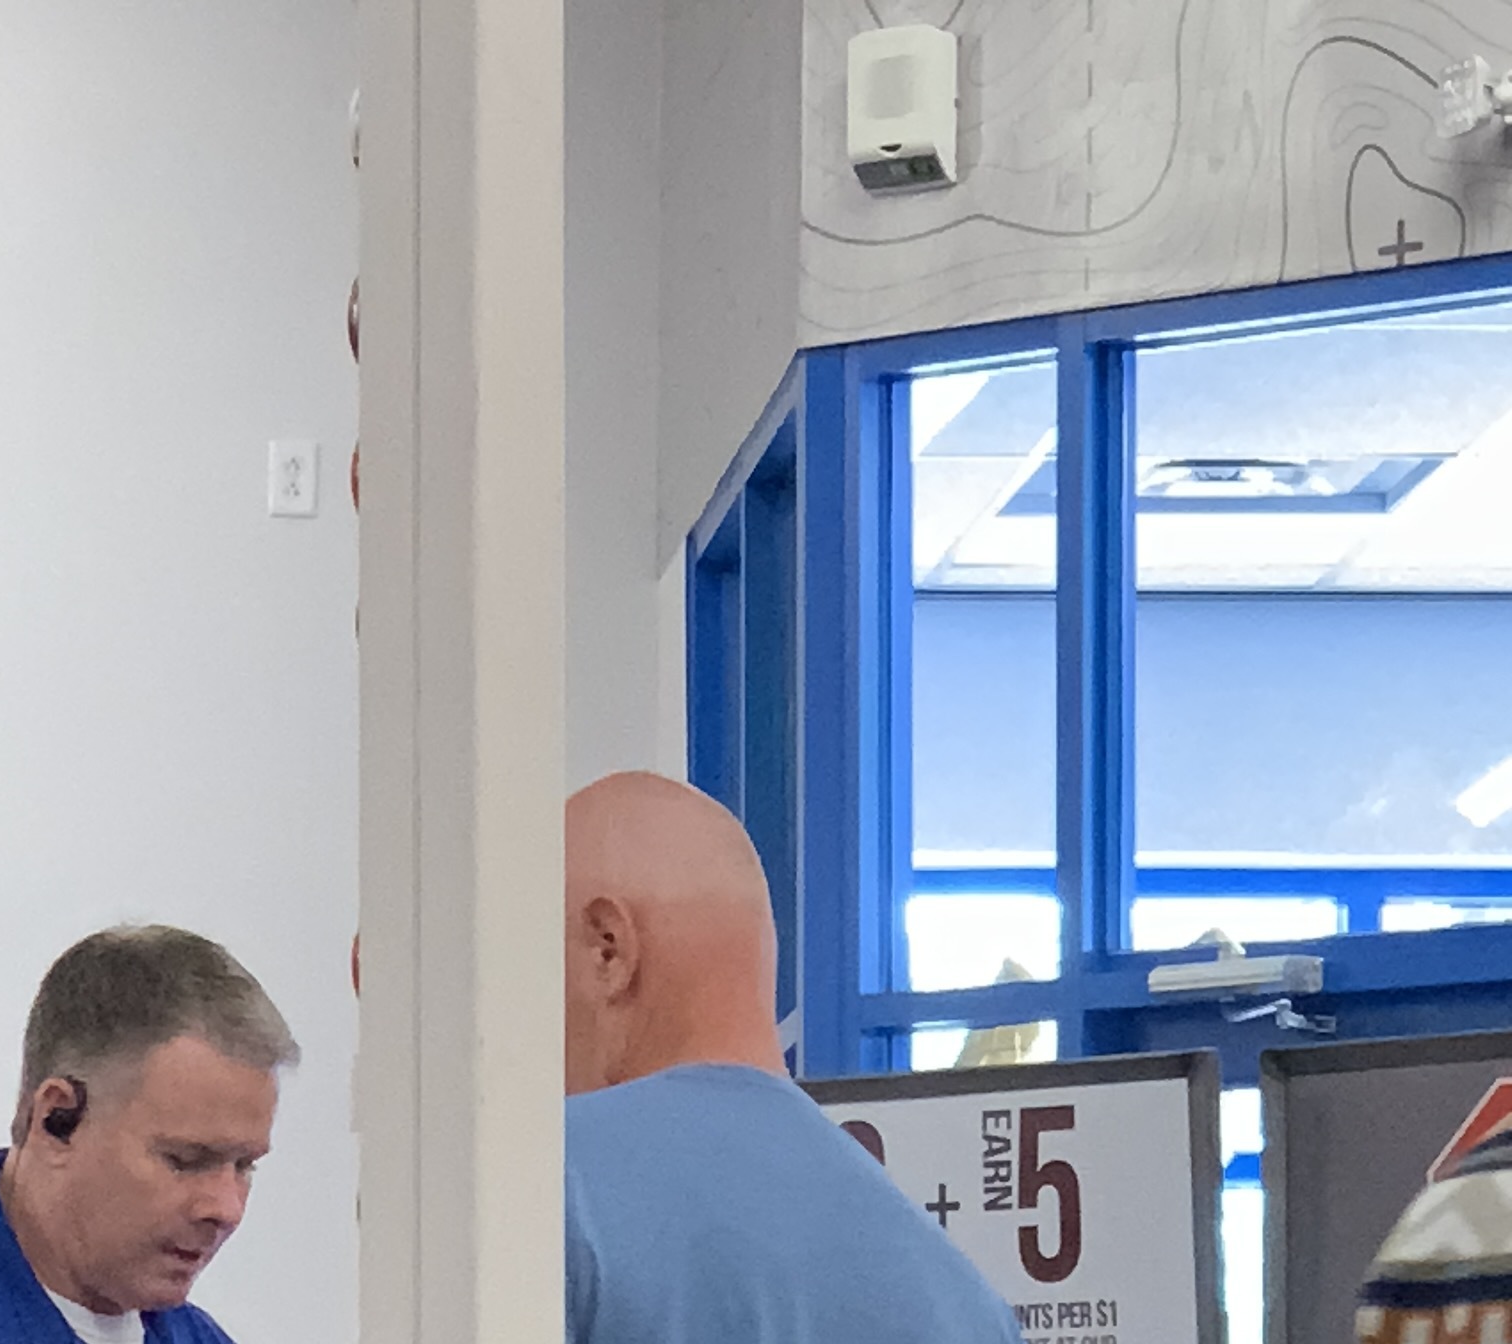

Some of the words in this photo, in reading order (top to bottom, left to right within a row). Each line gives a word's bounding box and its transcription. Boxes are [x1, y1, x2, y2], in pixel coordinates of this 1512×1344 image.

[982, 1109, 1013, 1212] EARN
[1018, 1105, 1082, 1284] 5
[1057, 1302, 1092, 1328] PER
[1096, 1299, 1118, 1327] $1
